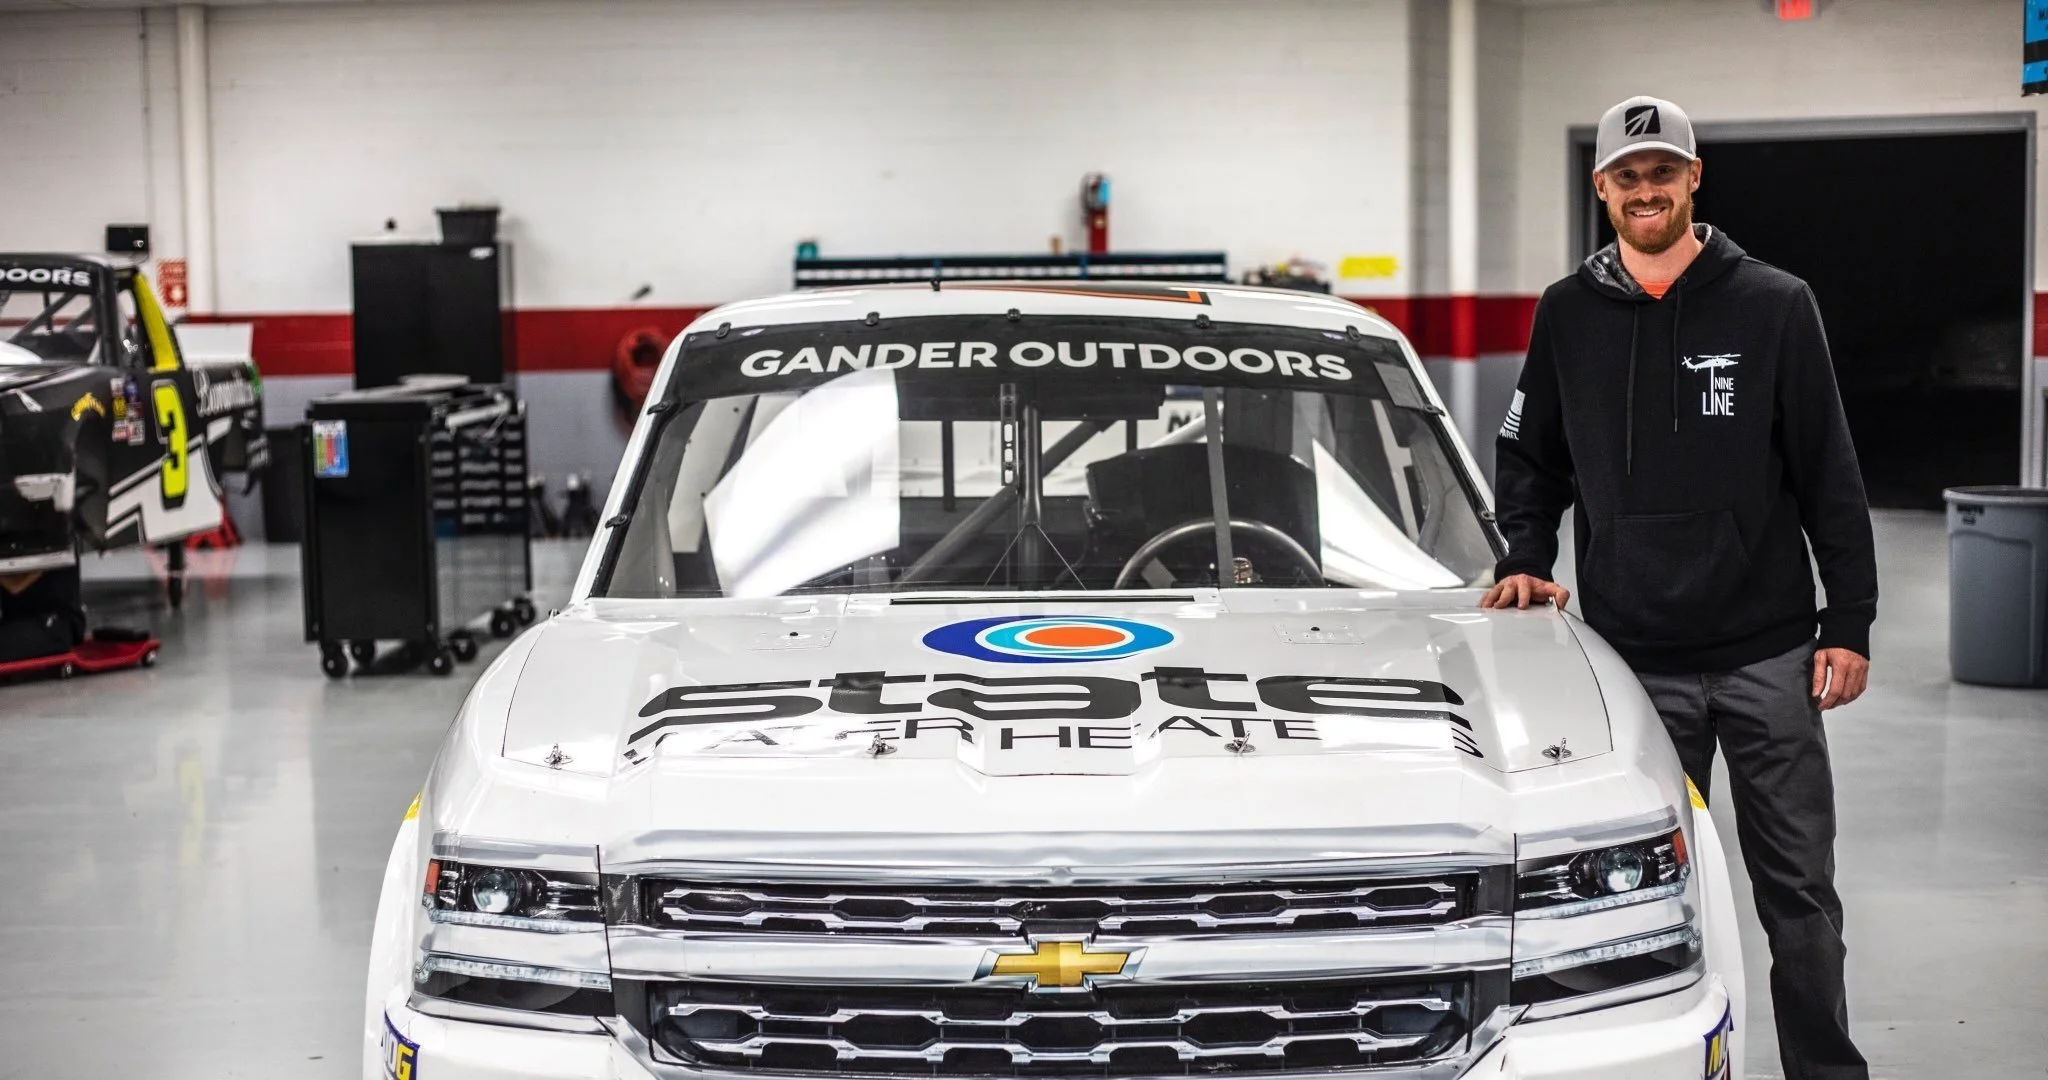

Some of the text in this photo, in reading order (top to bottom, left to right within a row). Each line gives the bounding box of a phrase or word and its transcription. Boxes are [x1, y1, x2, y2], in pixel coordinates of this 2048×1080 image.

[740, 341, 1353, 381] GANDER OUTDOORS
[1702, 391, 1735, 416] LINE
[1714, 376, 1735, 391] NINE
[153, 382, 188, 500] 3
[627, 666, 1473, 745] state
[1000, 715, 1484, 759] HEATES
